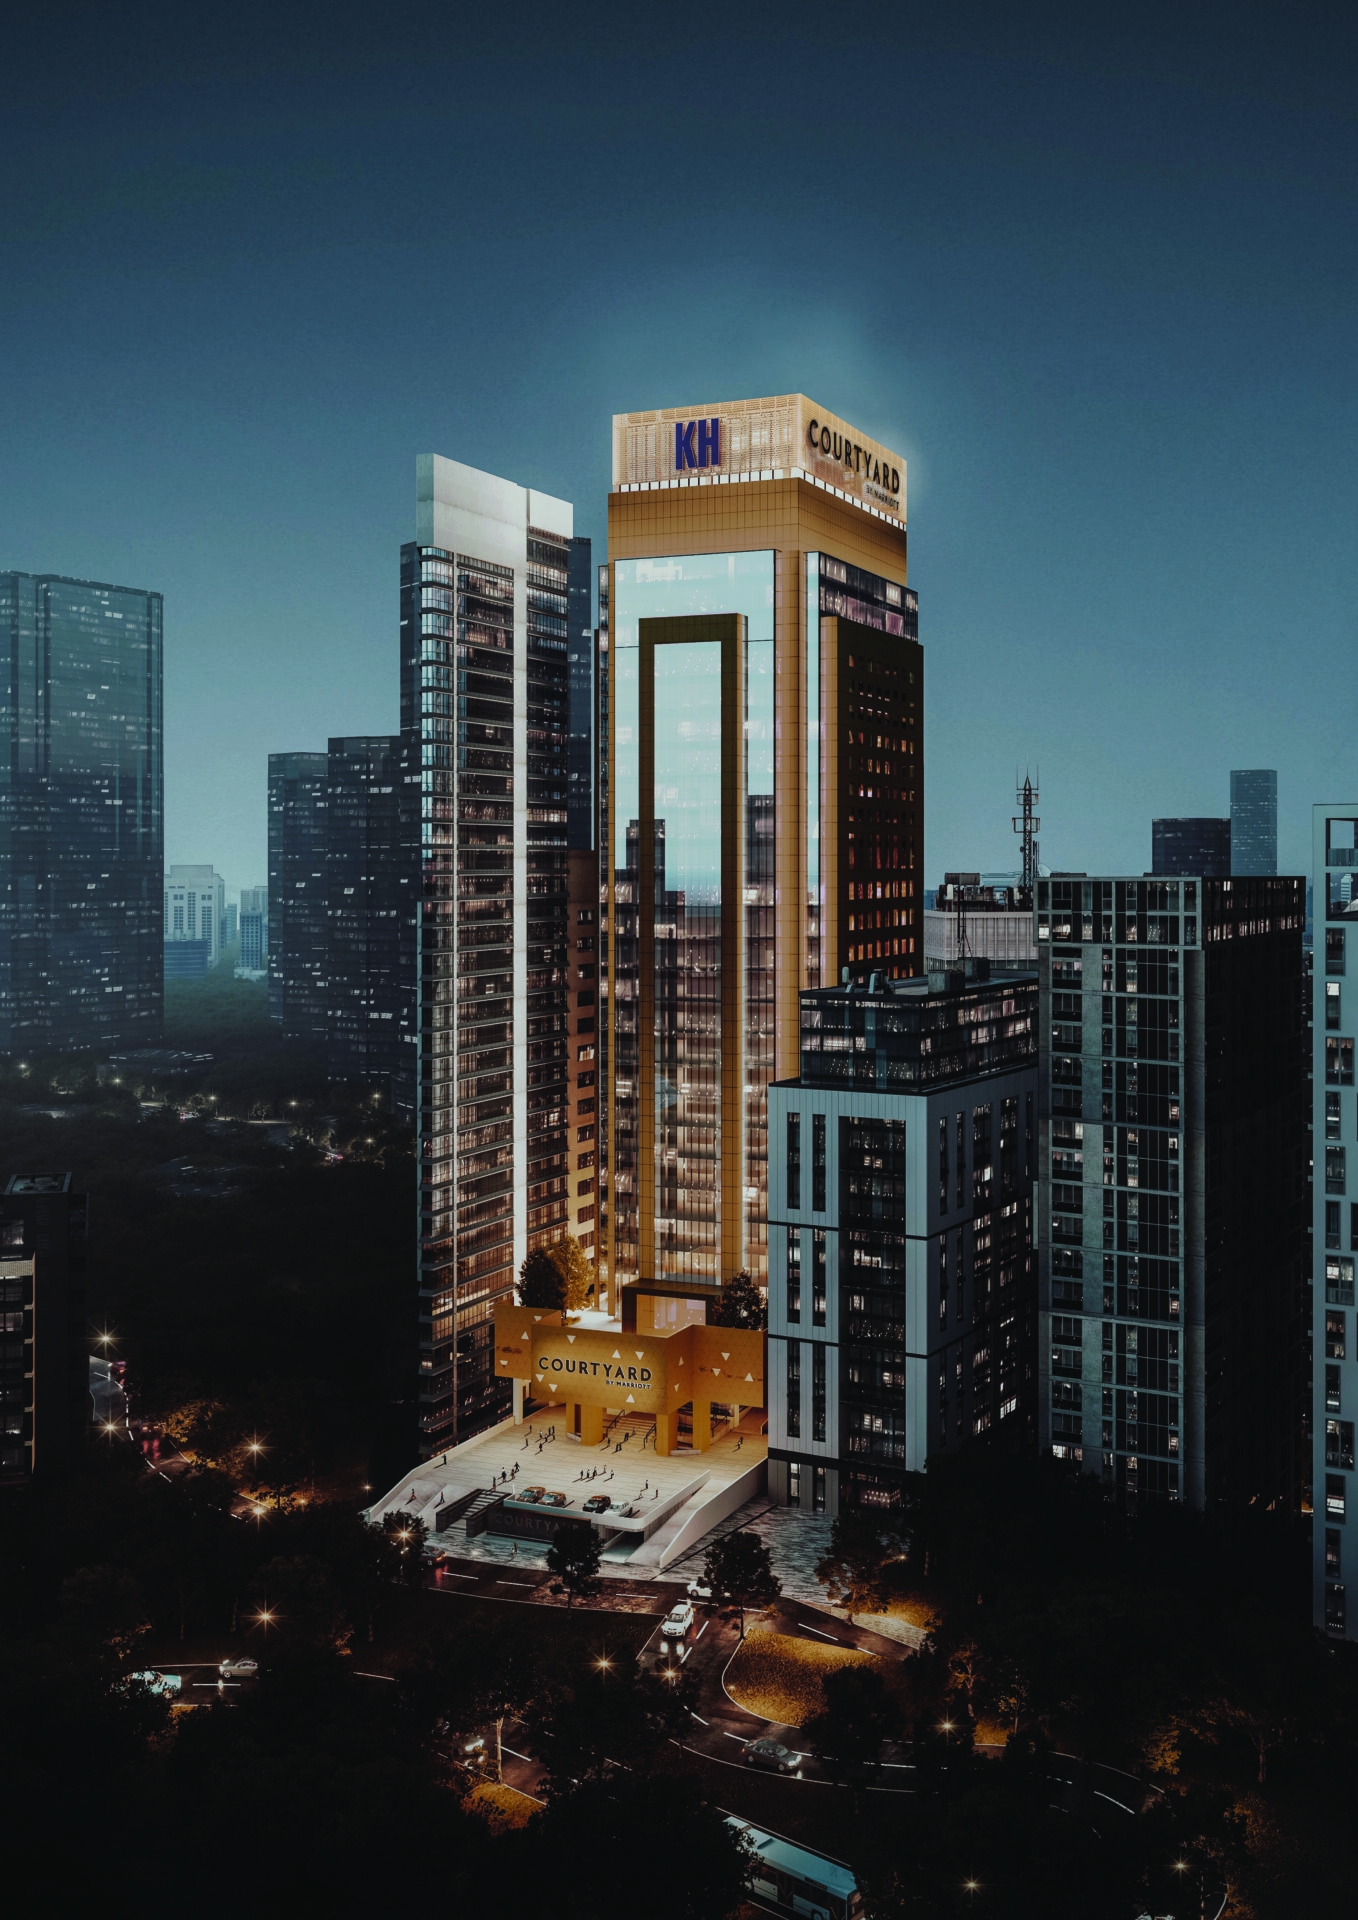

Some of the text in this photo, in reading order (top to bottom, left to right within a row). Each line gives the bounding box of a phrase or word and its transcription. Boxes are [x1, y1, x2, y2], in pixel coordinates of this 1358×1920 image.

[675, 418, 720, 470] KH
[808, 419, 900, 494] COURTYARD
[874, 489, 900, 511] MARRIOTT
[538, 1357, 652, 1381] COURTYARD
[616, 1381, 651, 1389] MARRIOTT
[495, 1513, 579, 1531] COURTYA
